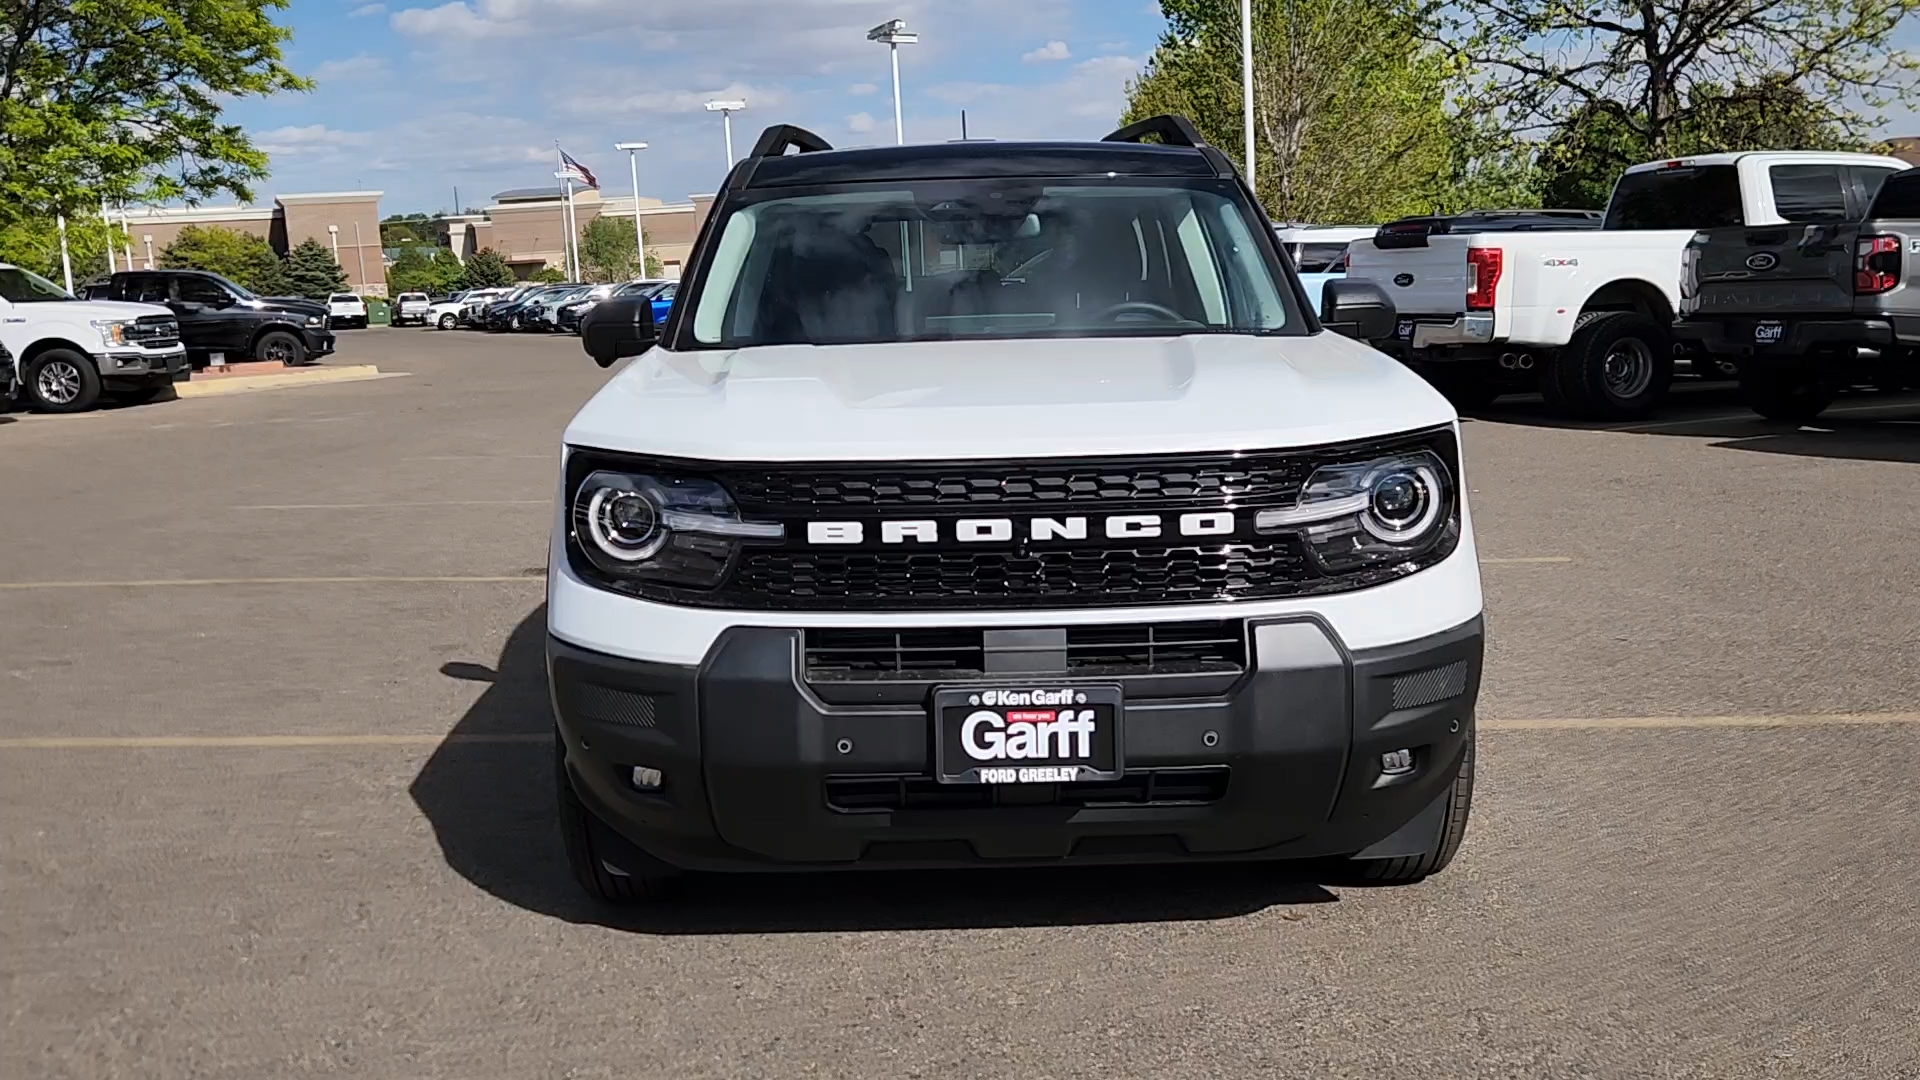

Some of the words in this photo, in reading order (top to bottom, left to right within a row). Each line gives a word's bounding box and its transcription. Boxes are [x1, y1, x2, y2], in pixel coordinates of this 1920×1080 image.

[1755, 325, 1782, 338] Garff
[807, 511, 1235, 544] BRONCO
[997, 690, 1030, 705] Ken
[1031, 689, 1074, 705] Garff
[961, 709, 1096, 760] Garff
[980, 768, 1016, 784] FORD
[1018, 767, 1079, 783] GREELEY
